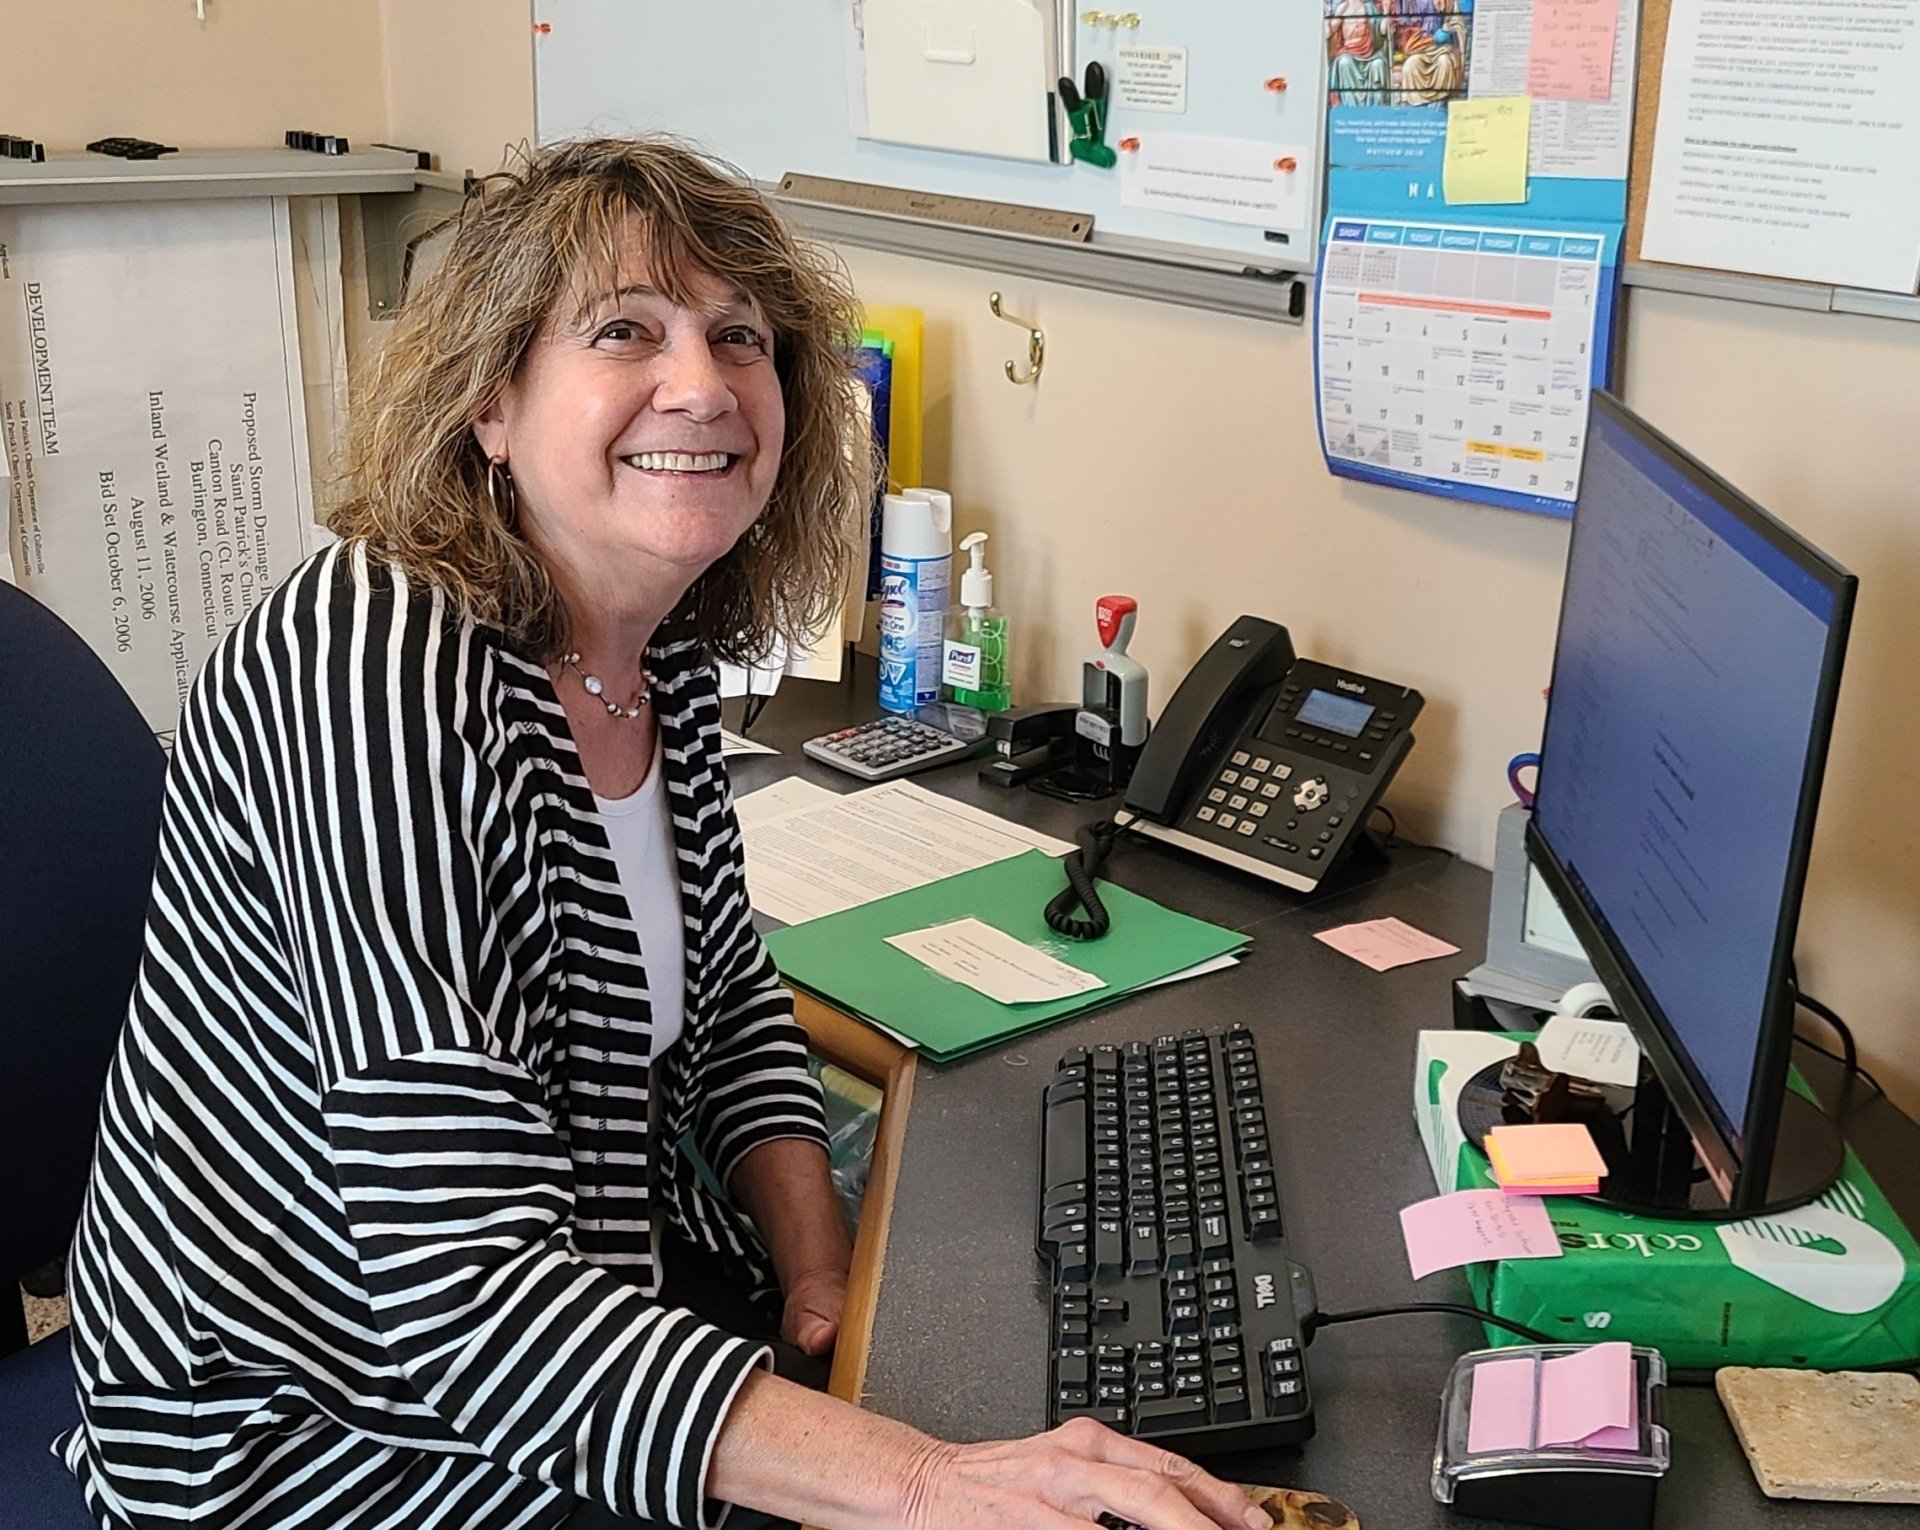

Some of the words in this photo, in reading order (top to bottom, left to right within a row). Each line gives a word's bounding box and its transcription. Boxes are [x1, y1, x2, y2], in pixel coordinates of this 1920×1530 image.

[1462, 330, 1467, 340] 5
[1542, 338, 1547, 349] 7
[27, 282, 54, 405] DEVELOPMENT
[43, 408, 59, 454] TEAM
[149, 391, 165, 439] Inland
[242, 393, 261, 460] Proposed
[11, 455, 20, 480] Church
[25, 453, 33, 478] Church
[99, 471, 114, 498] Bid
[155, 443, 172, 507] Wetland
[209, 439, 222, 493] Canton
[230, 464, 244, 501] Saint
[13, 483, 25, 524] Corporation
[26, 481, 38, 523] Corporation
[249, 466, 265, 510] Storm
[103, 504, 118, 528] Set
[129, 497, 145, 551] August
[161, 512, 174, 527] &
[214, 498, 229, 536] Road
[191, 461, 208, 546] Burlington,
[200, 550, 218, 639] Connecticut
[215, 541, 232, 568] (Ct.
[233, 506, 251, 568] Patrick's
[253, 516, 270, 581] Drainage
[105, 532, 122, 592] October
[136, 556, 152, 579] 11,
[163, 531, 183, 624] Watercourse
[111, 597, 127, 611] 6,
[140, 583, 156, 620] 2006
[221, 574, 235, 616] Route
[240, 572, 253, 614] Churc
[115, 615, 131, 652] 2006
[171, 629, 188, 710] Applicatio
[1560, 1233, 1702, 1257] colors
[1254, 1275, 1275, 1308] DELL
